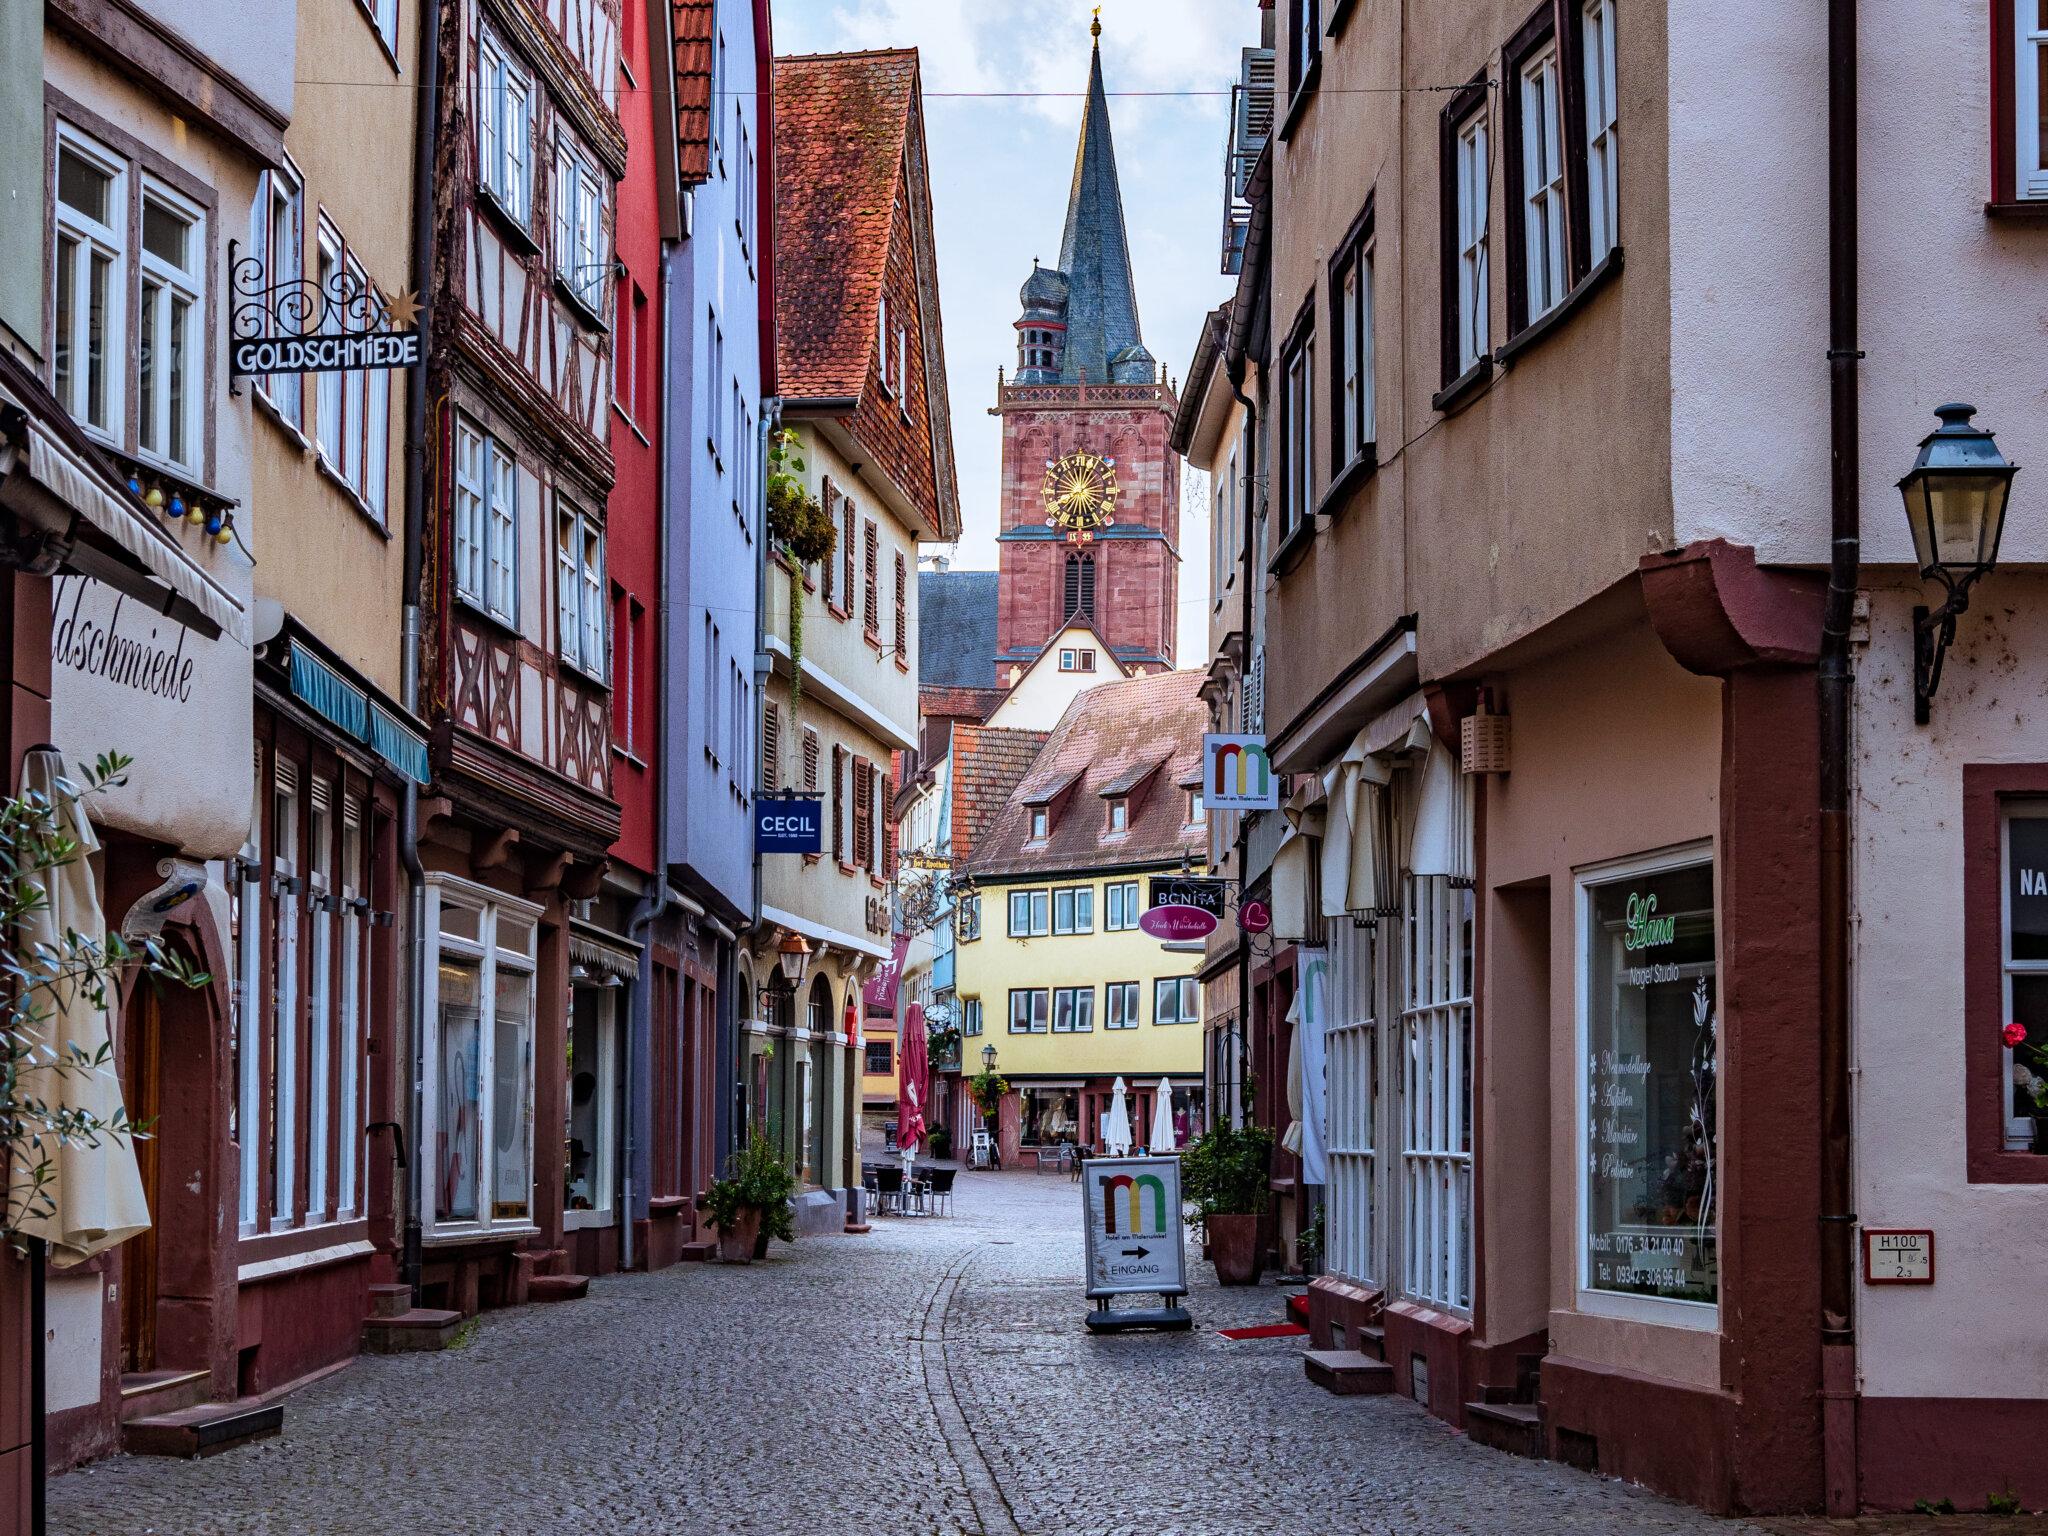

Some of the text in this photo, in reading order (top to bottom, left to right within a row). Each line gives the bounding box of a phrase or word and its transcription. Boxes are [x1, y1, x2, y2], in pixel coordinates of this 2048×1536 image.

[236, 334, 418, 373] GOLDSCHMIEDE
[761, 816, 815, 832] CECIL
[1630, 962, 1680, 989] Nagel Studio
[1589, 1234, 1611, 1251] Mobil:
[1616, 1236, 1634, 1254] 0176
[1111, 1264, 1159, 1275] EINGANG
[1598, 1263, 1611, 1281] Tel:
[1616, 1265, 1640, 1284] 09342
